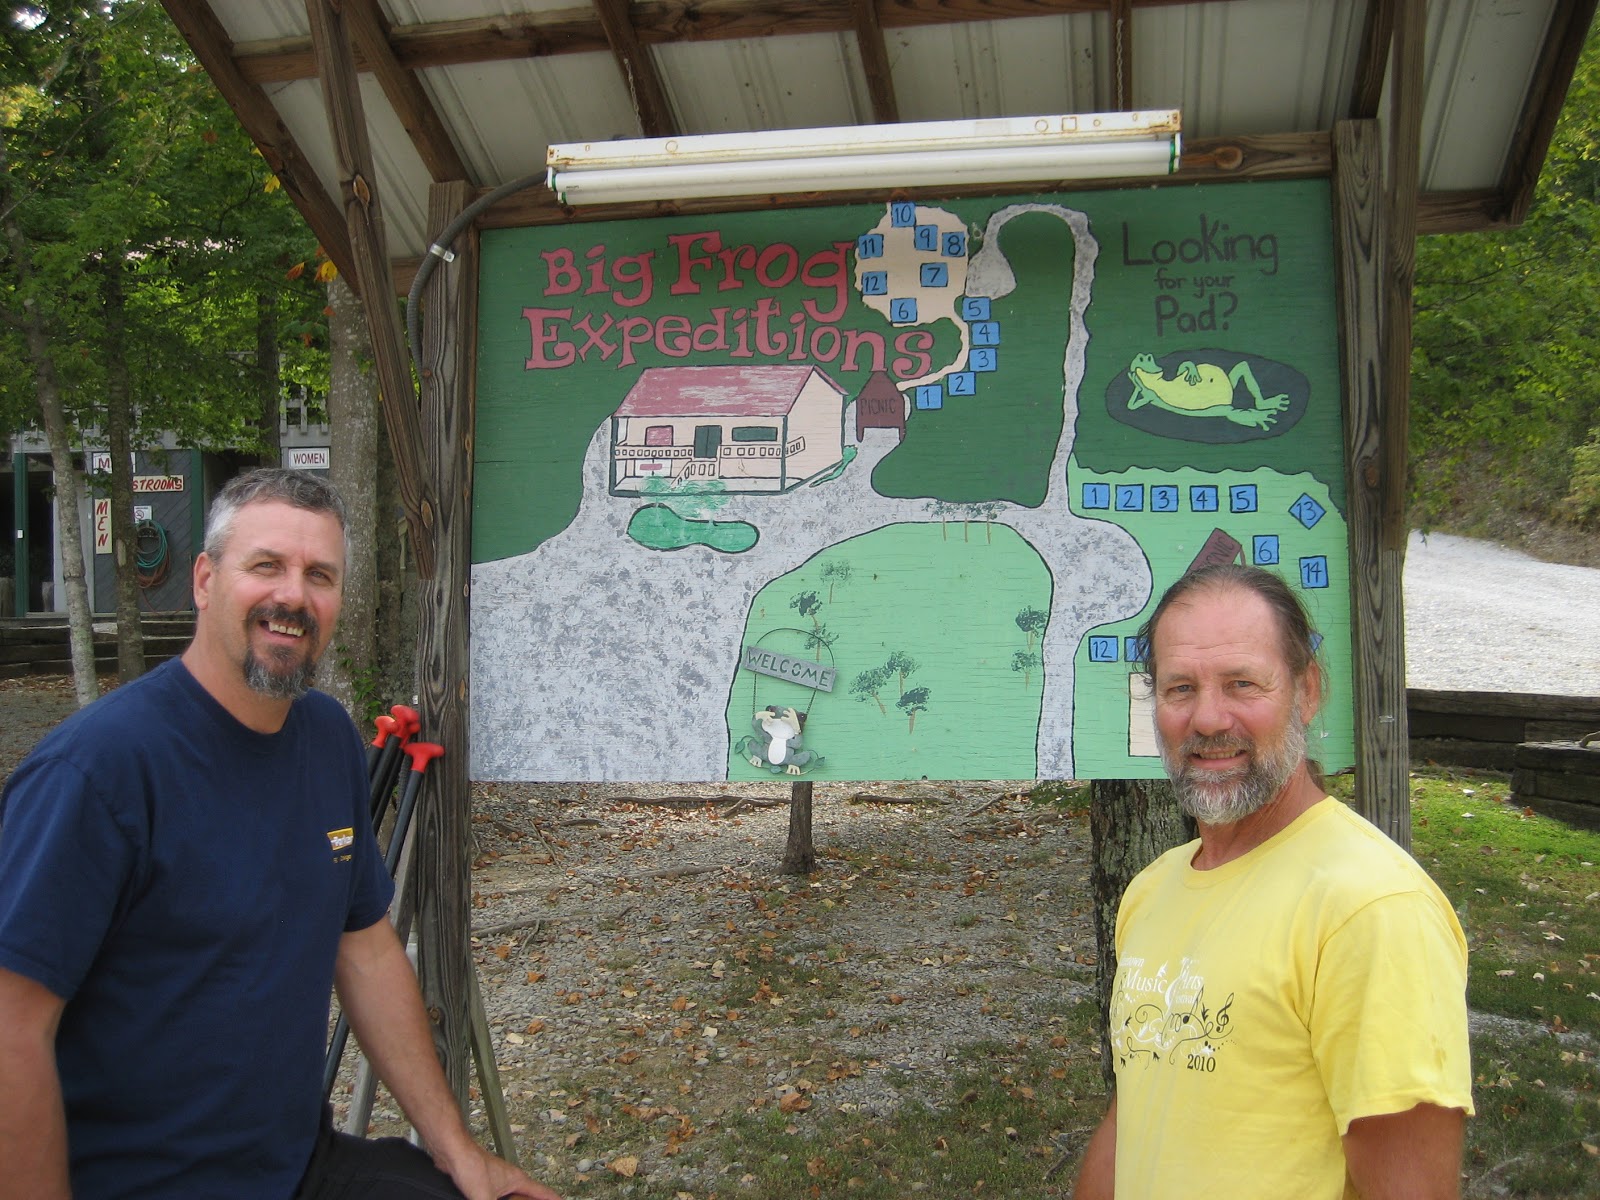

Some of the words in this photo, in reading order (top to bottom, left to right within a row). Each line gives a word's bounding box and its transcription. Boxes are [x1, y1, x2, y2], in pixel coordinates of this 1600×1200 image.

[894, 205, 912, 224] 10
[919, 227, 931, 244] 9
[1122, 213, 1279, 276] Looking
[861, 239, 876, 255] 11
[947, 235, 962, 256] 8
[540, 245, 655, 307] Big
[667, 230, 855, 324] Frog
[864, 276, 879, 293] 12
[927, 267, 942, 283] 7
[1154, 267, 1187, 290] for
[1193, 275, 1235, 299] your
[898, 303, 909, 320] 6
[968, 300, 982, 317] 5
[1154, 291, 1239, 337] Pad?
[521, 296, 934, 380] Expeditions
[978, 324, 991, 343] 4
[977, 351, 990, 368] 3
[955, 376, 967, 393] 2
[860, 398, 896, 416] PICNIC
[923, 389, 931, 407] 1
[293, 453, 325, 465] WOMEN
[132, 478, 182, 491] STROOMS
[1091, 487, 1098, 504] 1
[1123, 489, 1137, 508] 2
[1157, 490, 1171, 509] 3
[1195, 490, 1208, 510] 4
[1236, 490, 1250, 509] 5
[1296, 501, 1318, 522] 13
[96, 501, 109, 547] MEN
[1258, 540, 1272, 562] 6
[1303, 561, 1322, 584] 14
[1093, 640, 1113, 659] 12
[748, 651, 831, 687] WELCOME
[1122, 967, 1168, 993] Music
[1187, 1054, 1216, 1073] 2010
